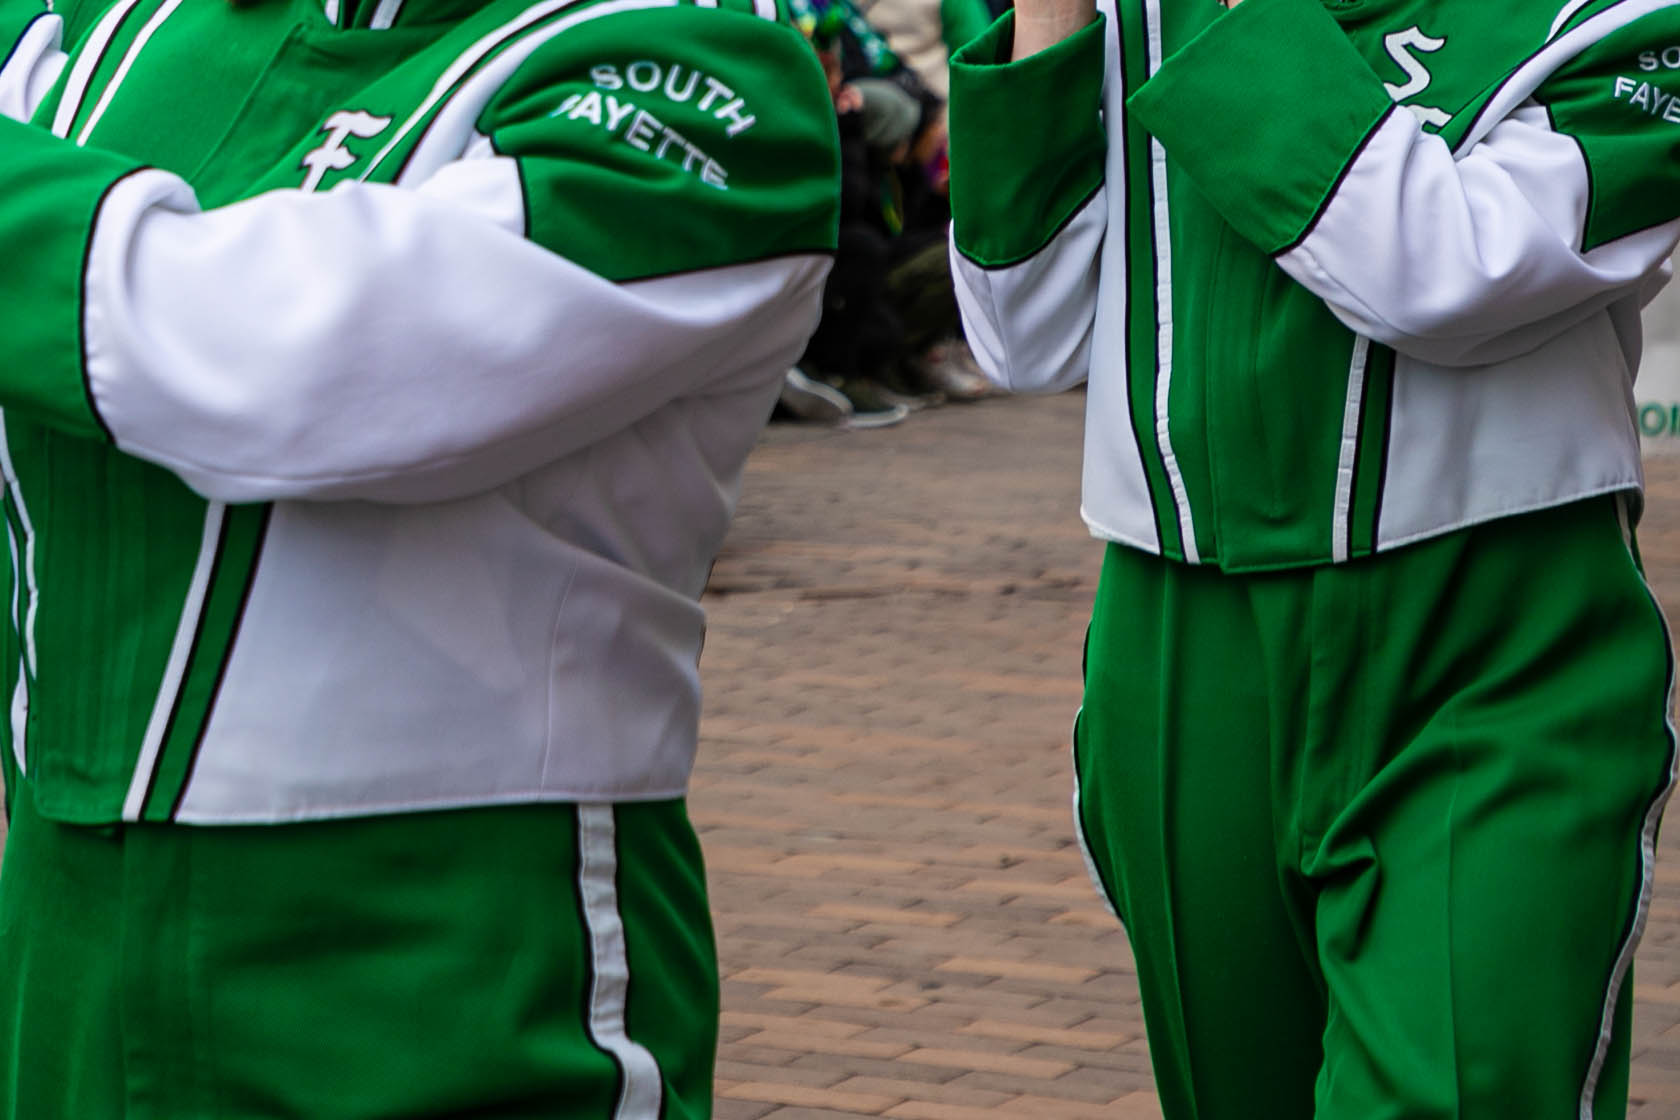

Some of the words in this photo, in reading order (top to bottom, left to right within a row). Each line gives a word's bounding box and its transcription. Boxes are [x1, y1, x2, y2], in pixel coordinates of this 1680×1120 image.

[1382, 25, 1446, 103] S
[1638, 46, 1680, 72] SO
[589, 60, 757, 137] SOUTH
